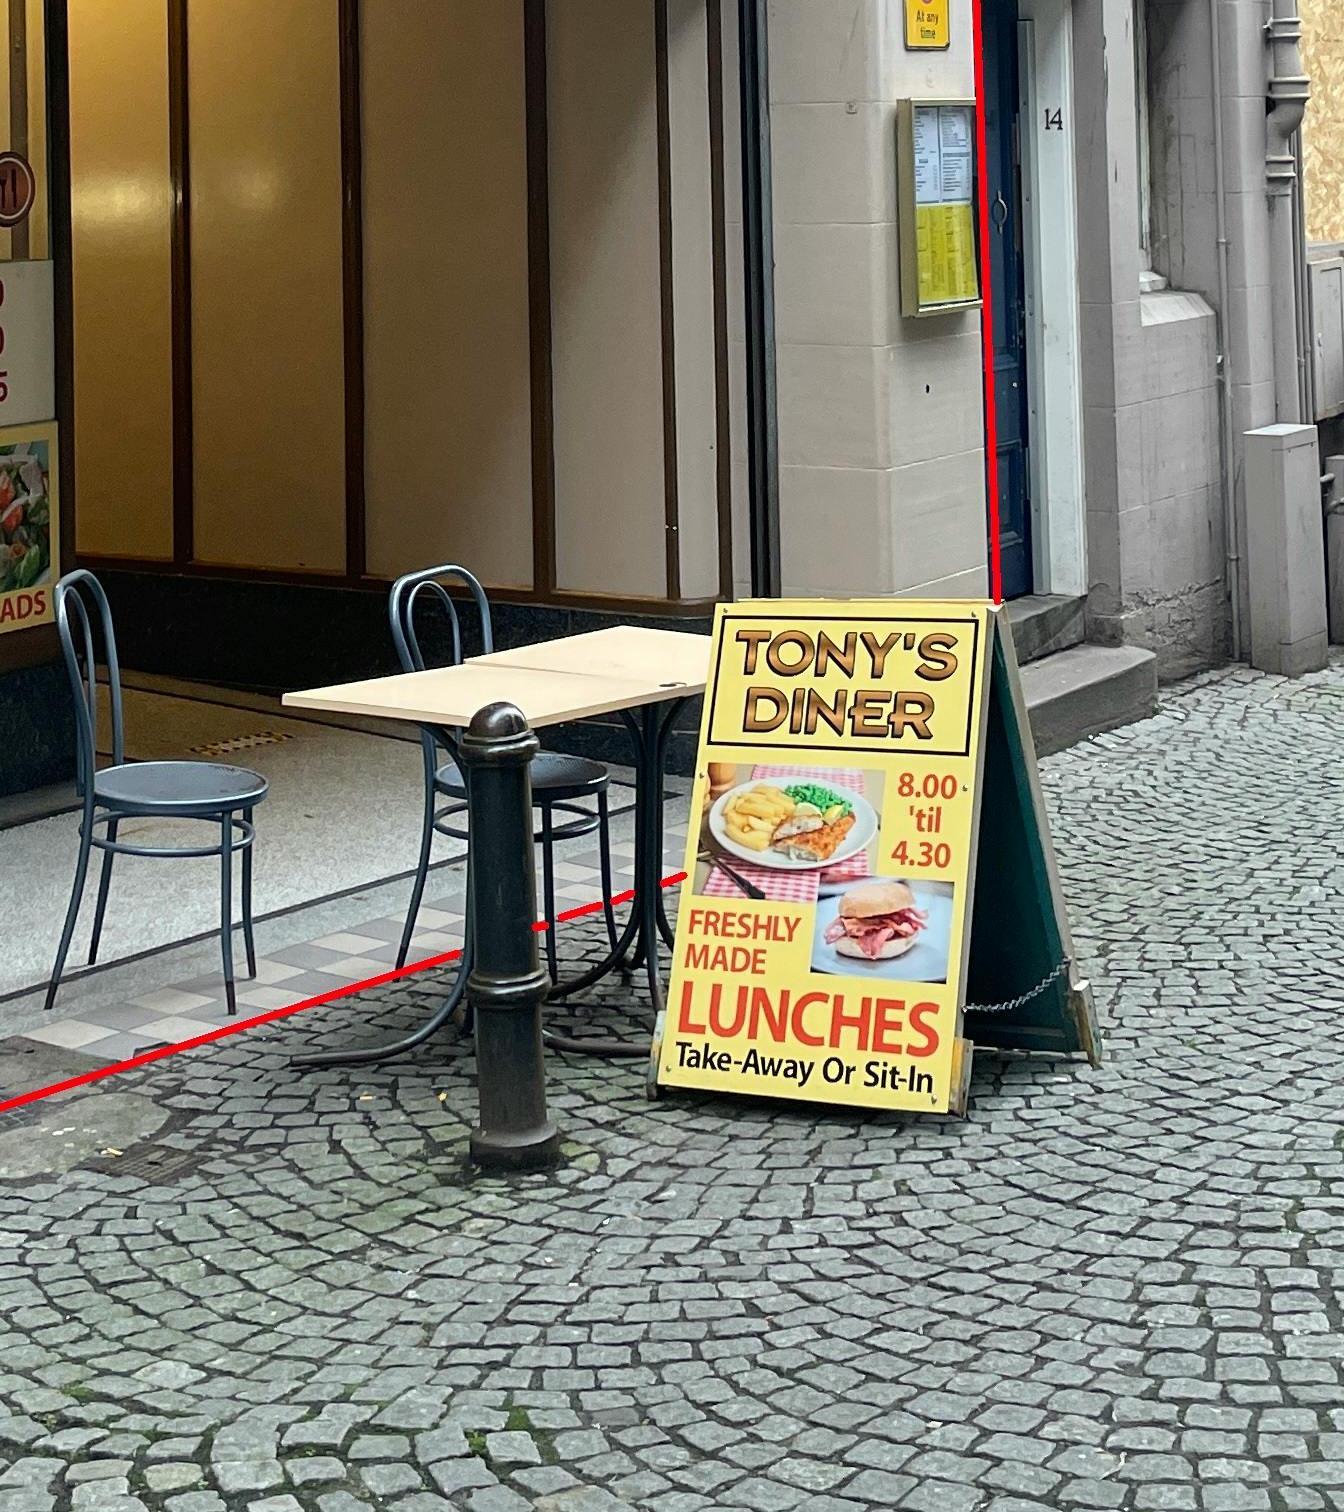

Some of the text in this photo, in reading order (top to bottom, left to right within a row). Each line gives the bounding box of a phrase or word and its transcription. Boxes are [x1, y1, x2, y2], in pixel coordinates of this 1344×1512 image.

[916, 11, 940, 26] At any
[920, 26, 937, 40] time
[1044, 108, 1063, 131] 14
[735, 629, 959, 682] TONY'S
[742, 687, 935, 740] DINER
[898, 773, 957, 800] 8.00
[908, 806, 941, 835] 'til
[891, 841, 951, 868] 4.30
[688, 909, 803, 943] FRESHLY
[684, 943, 766, 976] MADE
[677, 980, 940, 1057] LUNCHES
[676, 1041, 934, 1095] Take-Away Or Sit-In
